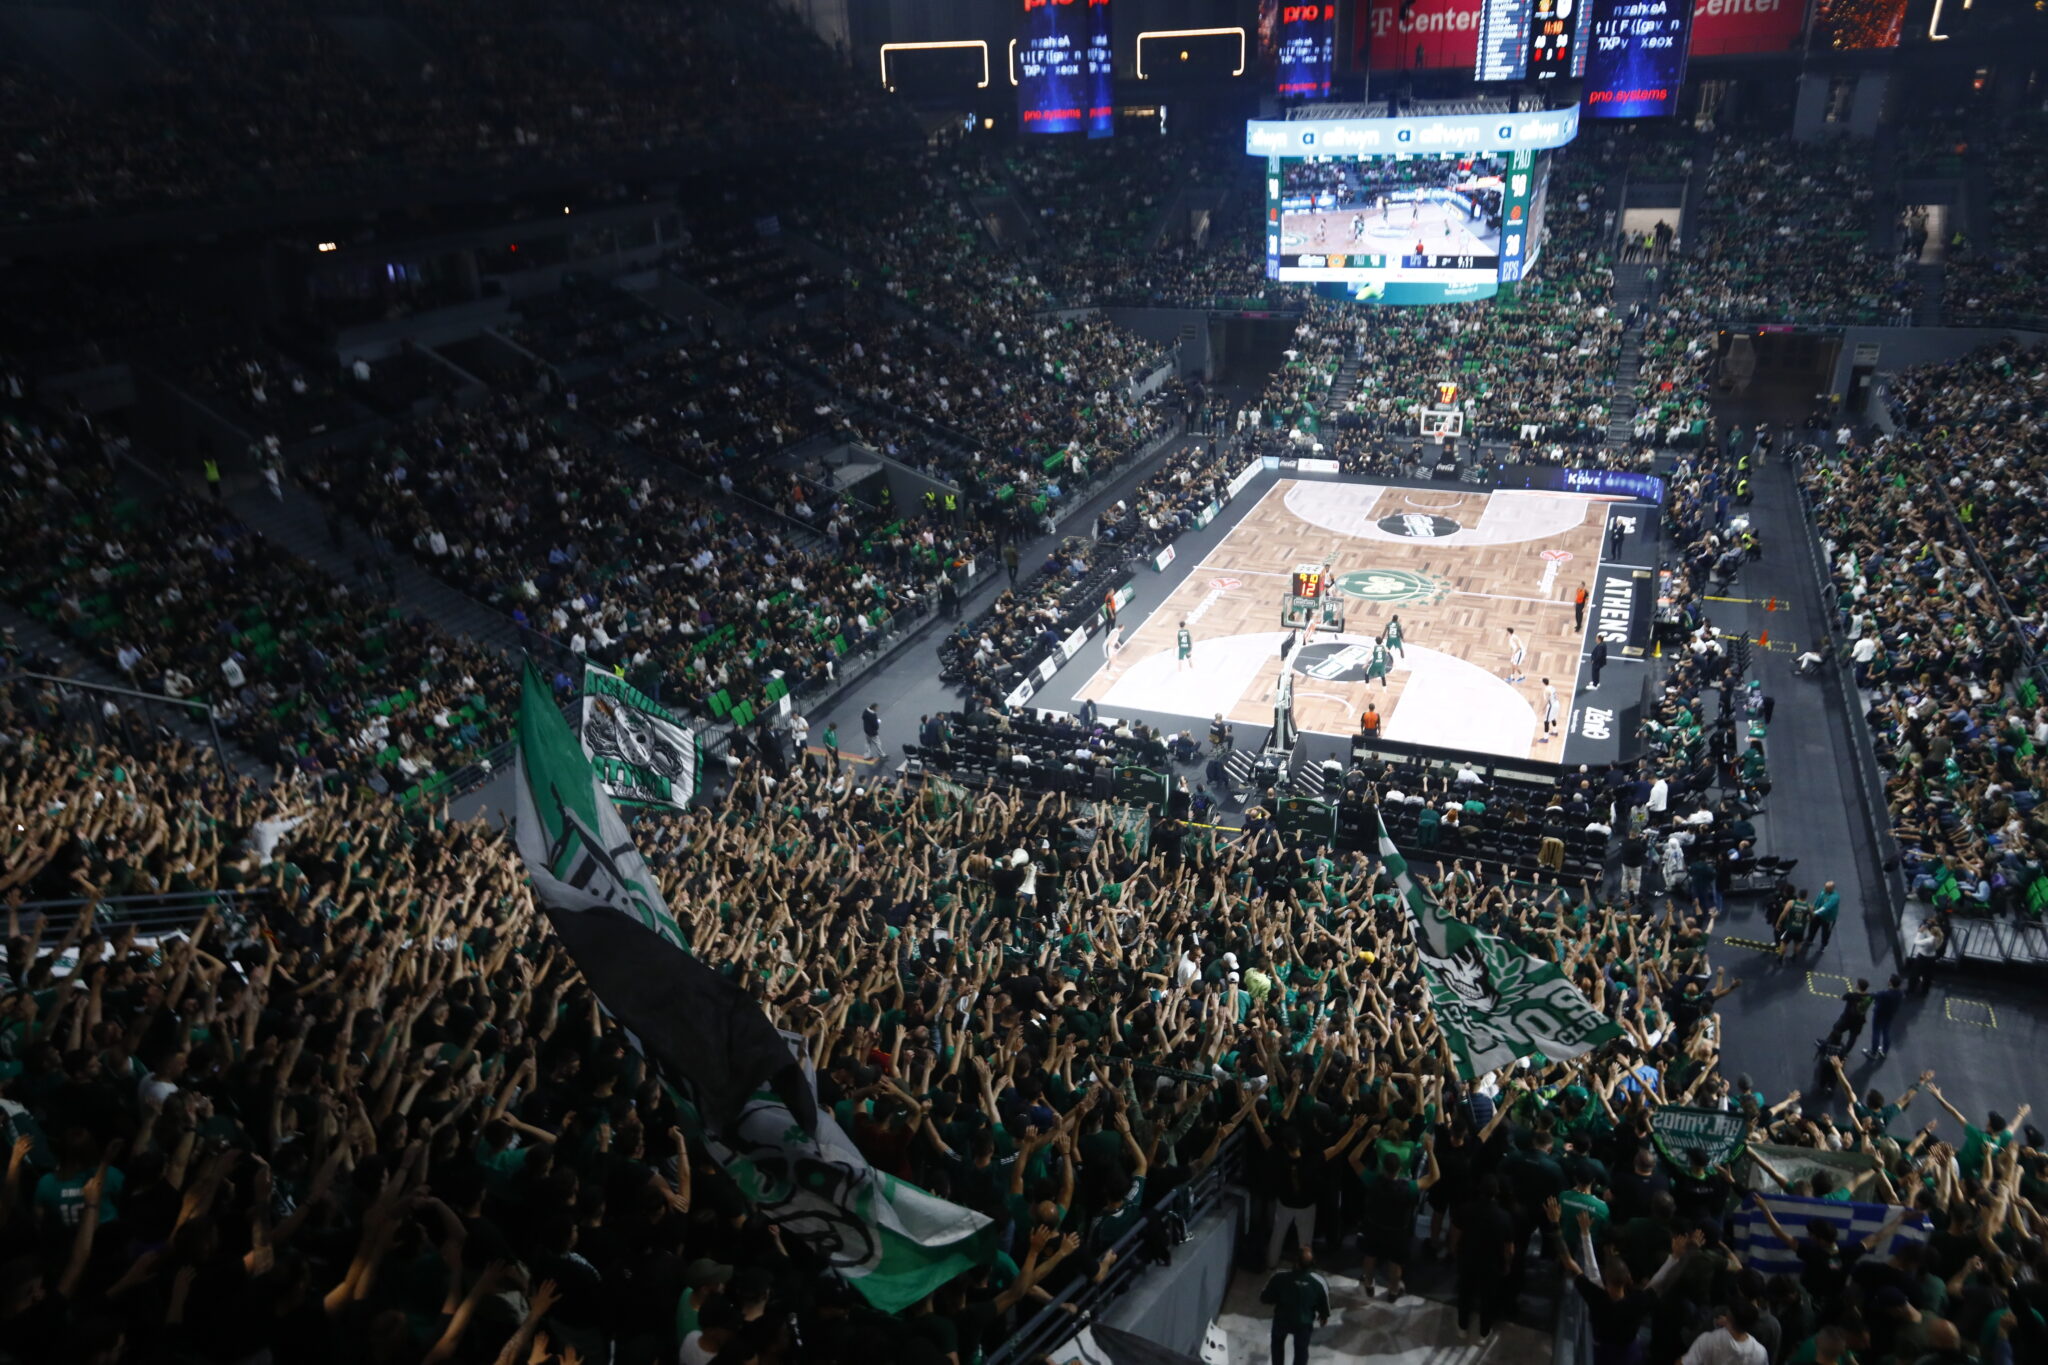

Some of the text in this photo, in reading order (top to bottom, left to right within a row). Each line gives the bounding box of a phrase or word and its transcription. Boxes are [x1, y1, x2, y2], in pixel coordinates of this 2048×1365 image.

[1399, 9, 1482, 32] Center
[1590, 88, 1667, 104] pno.systems
[1598, 577, 1633, 643] ATHENS
[1557, 1012, 1610, 1046] CLUB
